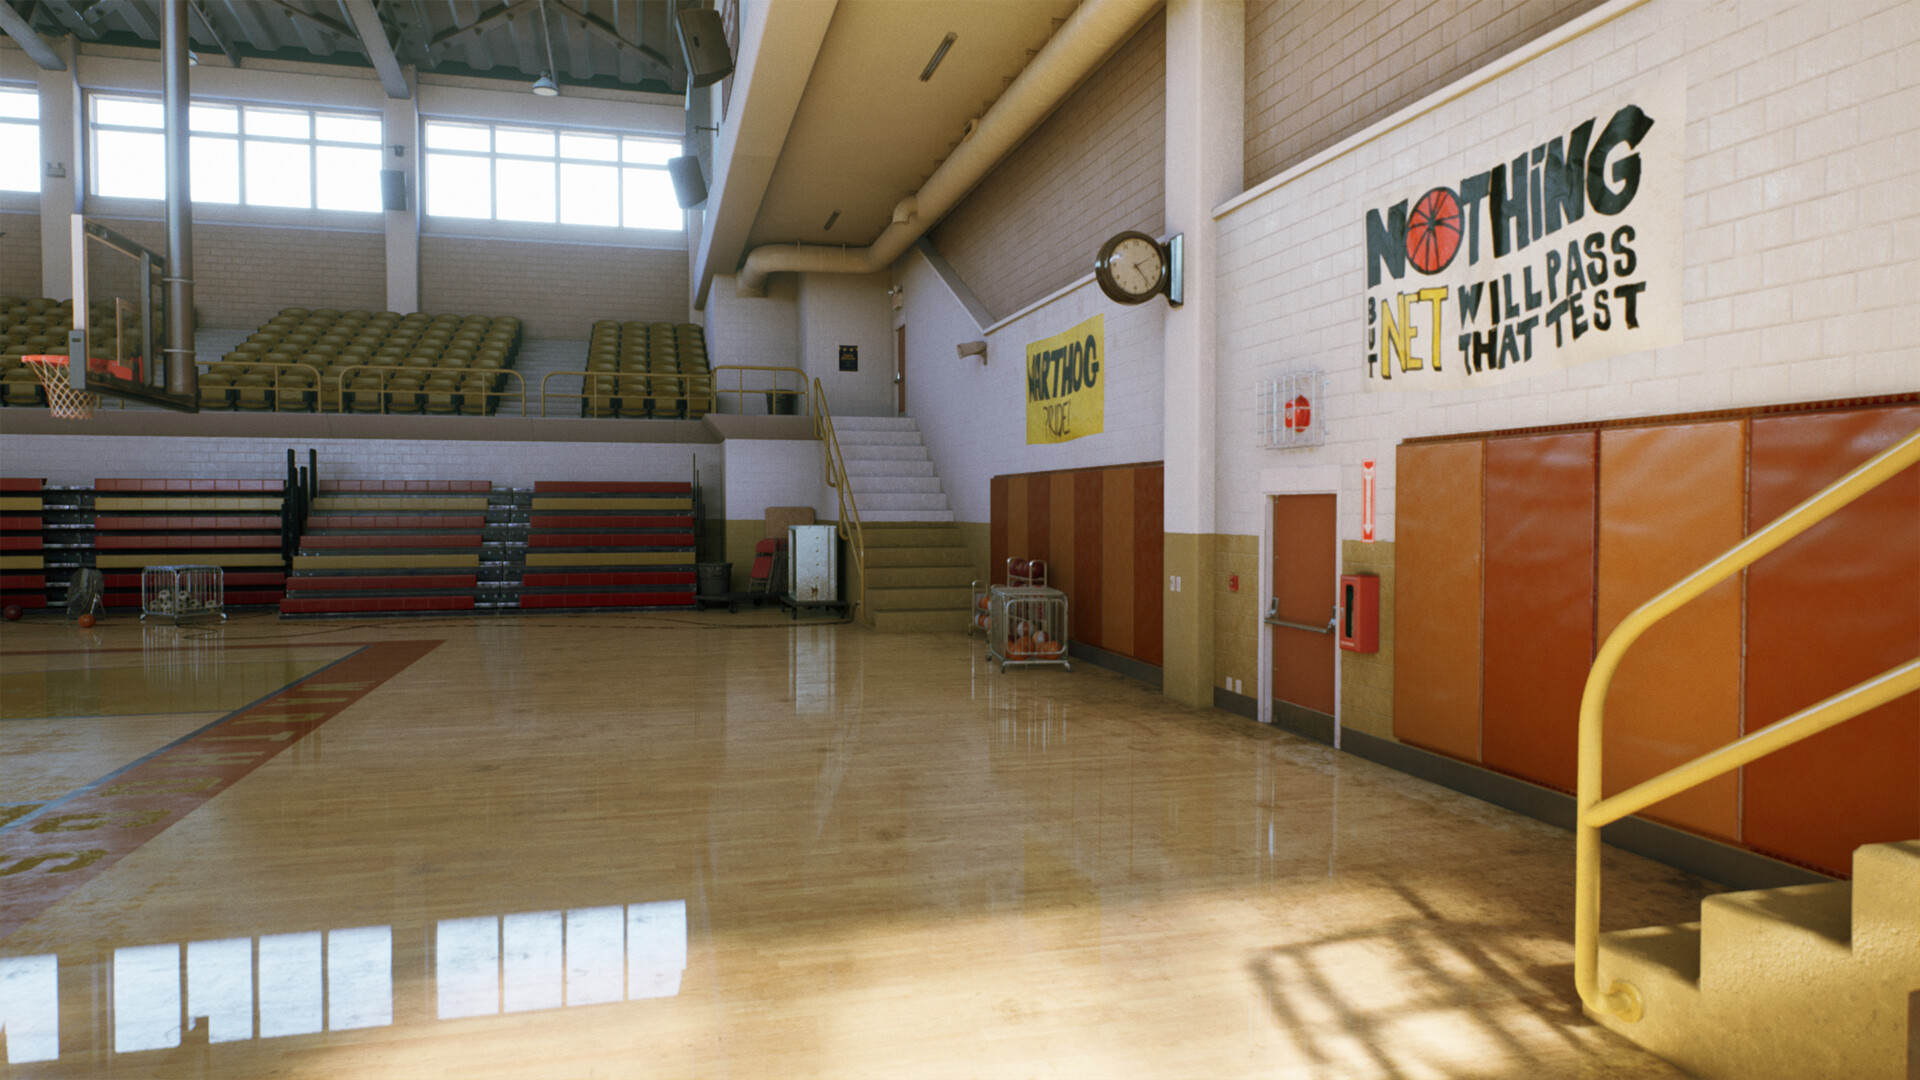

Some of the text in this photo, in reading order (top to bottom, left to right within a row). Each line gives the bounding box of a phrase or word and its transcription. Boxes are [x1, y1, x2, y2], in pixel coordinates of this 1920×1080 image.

[1457, 224, 1637, 330] WILL PASS
[1027, 334, 1099, 403] WARTHOG
[1367, 296, 1378, 378] BUT
[1381, 285, 1448, 380] NET
[1458, 281, 1647, 376] THAT TEST
